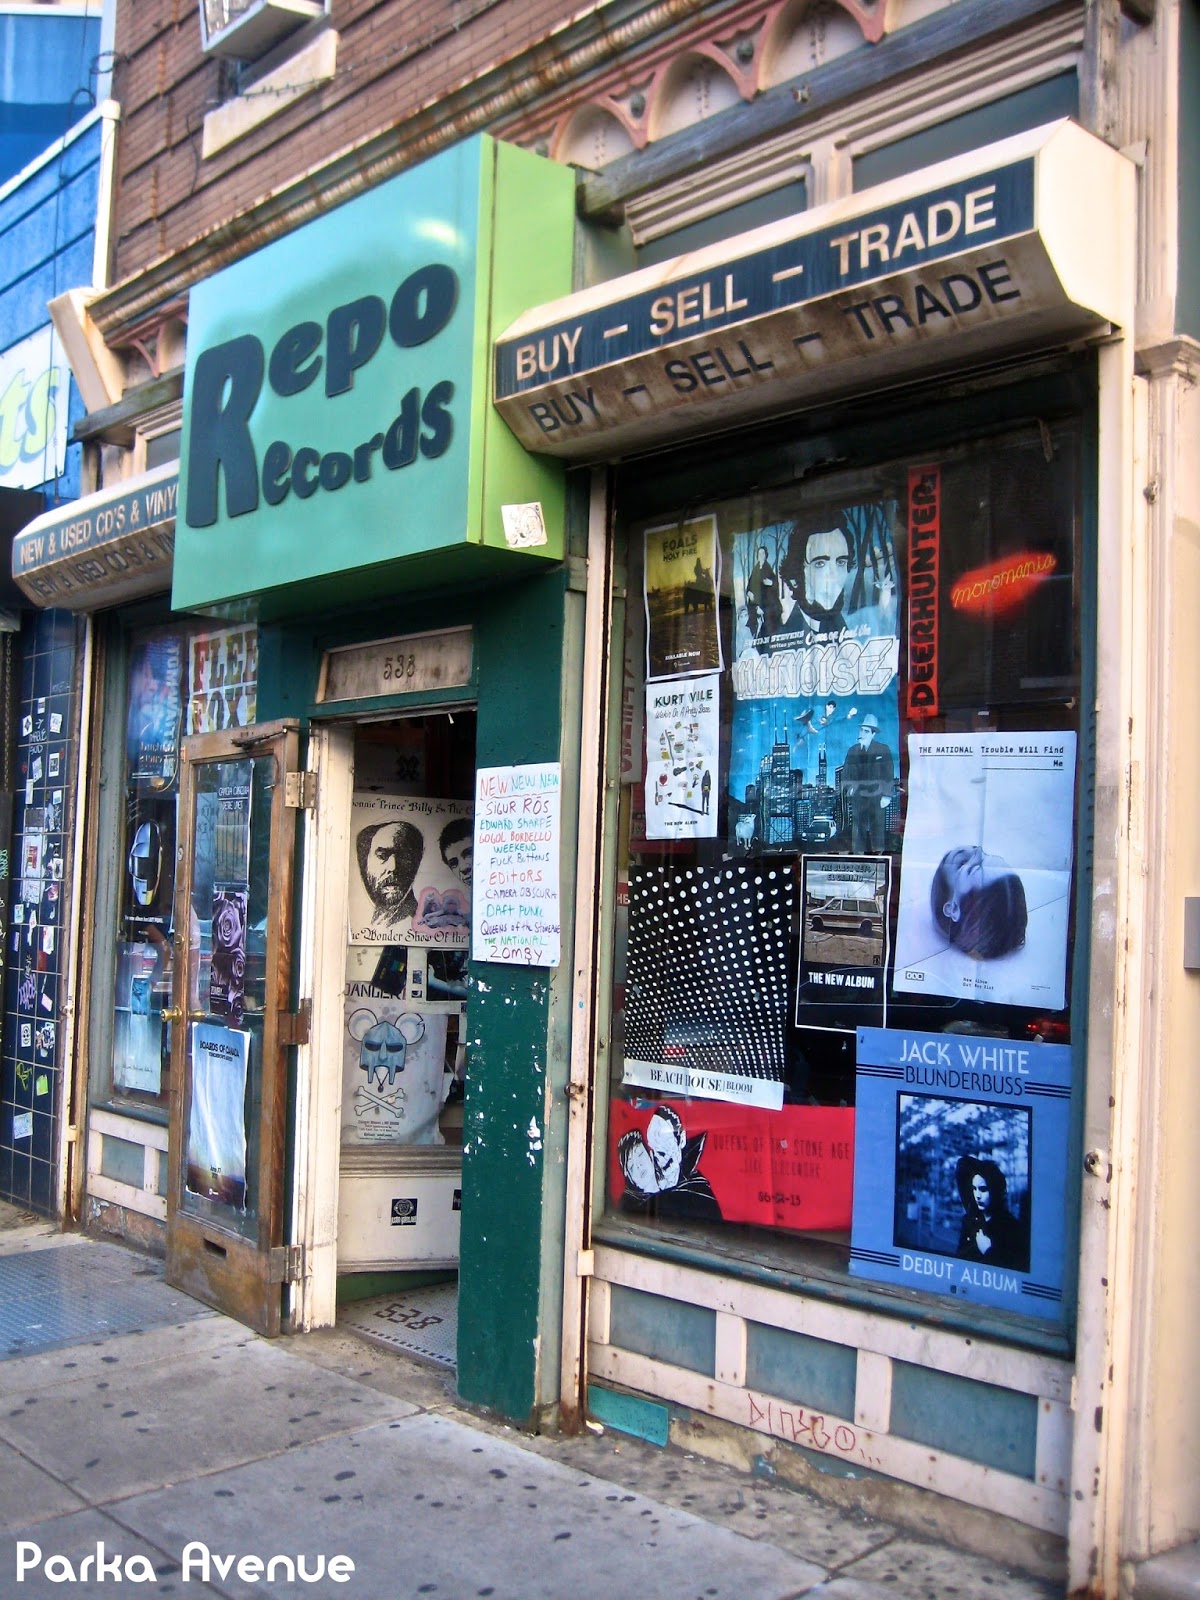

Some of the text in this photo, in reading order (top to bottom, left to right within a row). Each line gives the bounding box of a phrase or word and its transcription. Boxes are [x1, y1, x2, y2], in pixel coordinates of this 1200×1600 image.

[516, 326, 583, 381] BUY
[650, 274, 748, 337] SELL
[830, 184, 997, 275] TRADE
[528, 386, 601, 433] BUY
[664, 339, 776, 393] SELL
[842, 259, 1022, 340] TRADE
[20, 536, 45, 565] NEW
[48, 533, 57, 555] &
[60, 522, 92, 550] USED
[96, 504, 126, 537] CD'S
[130, 500, 140, 523] &
[662, 534, 698, 553] FOALS
[910, 472, 937, 708] DEERHUNTER
[952, 553, 1056, 608] monomania
[654, 689, 713, 708] KURT VILE
[919, 746, 1064, 754] THE NATIONAL Trouble Will Find
[480, 772, 559, 797] NEW NEW NEW
[352, 799, 376, 809] onnie
[409, 801, 433, 816] Billy
[479, 818, 514, 831] EDWARD
[510, 830, 552, 843] BORDELLO
[493, 843, 537, 854] WEEKEND
[490, 855, 514, 869] FUCK
[360, 927, 403, 942] Wonder
[405, 929, 432, 942] Show
[484, 937, 497, 945] THE
[808, 971, 875, 989] THE NEW ALBUM
[199, 1040, 219, 1052] BOARDS
[900, 1039, 1030, 1075] JACK WHITE
[650, 1069, 683, 1086] BEACH
[726, 1080, 753, 1094] BLOOM
[905, 1065, 1023, 1097] BLUNDERBUSS
[712, 1133, 748, 1152] QUEENS
[753, 1137, 765, 1153] OF
[793, 1138, 824, 1158] STONE
[831, 1142, 850, 1161] AGE
[902, 1254, 1018, 1294] DEBUT ALBUM
[373, 1303, 444, 1330] 538
